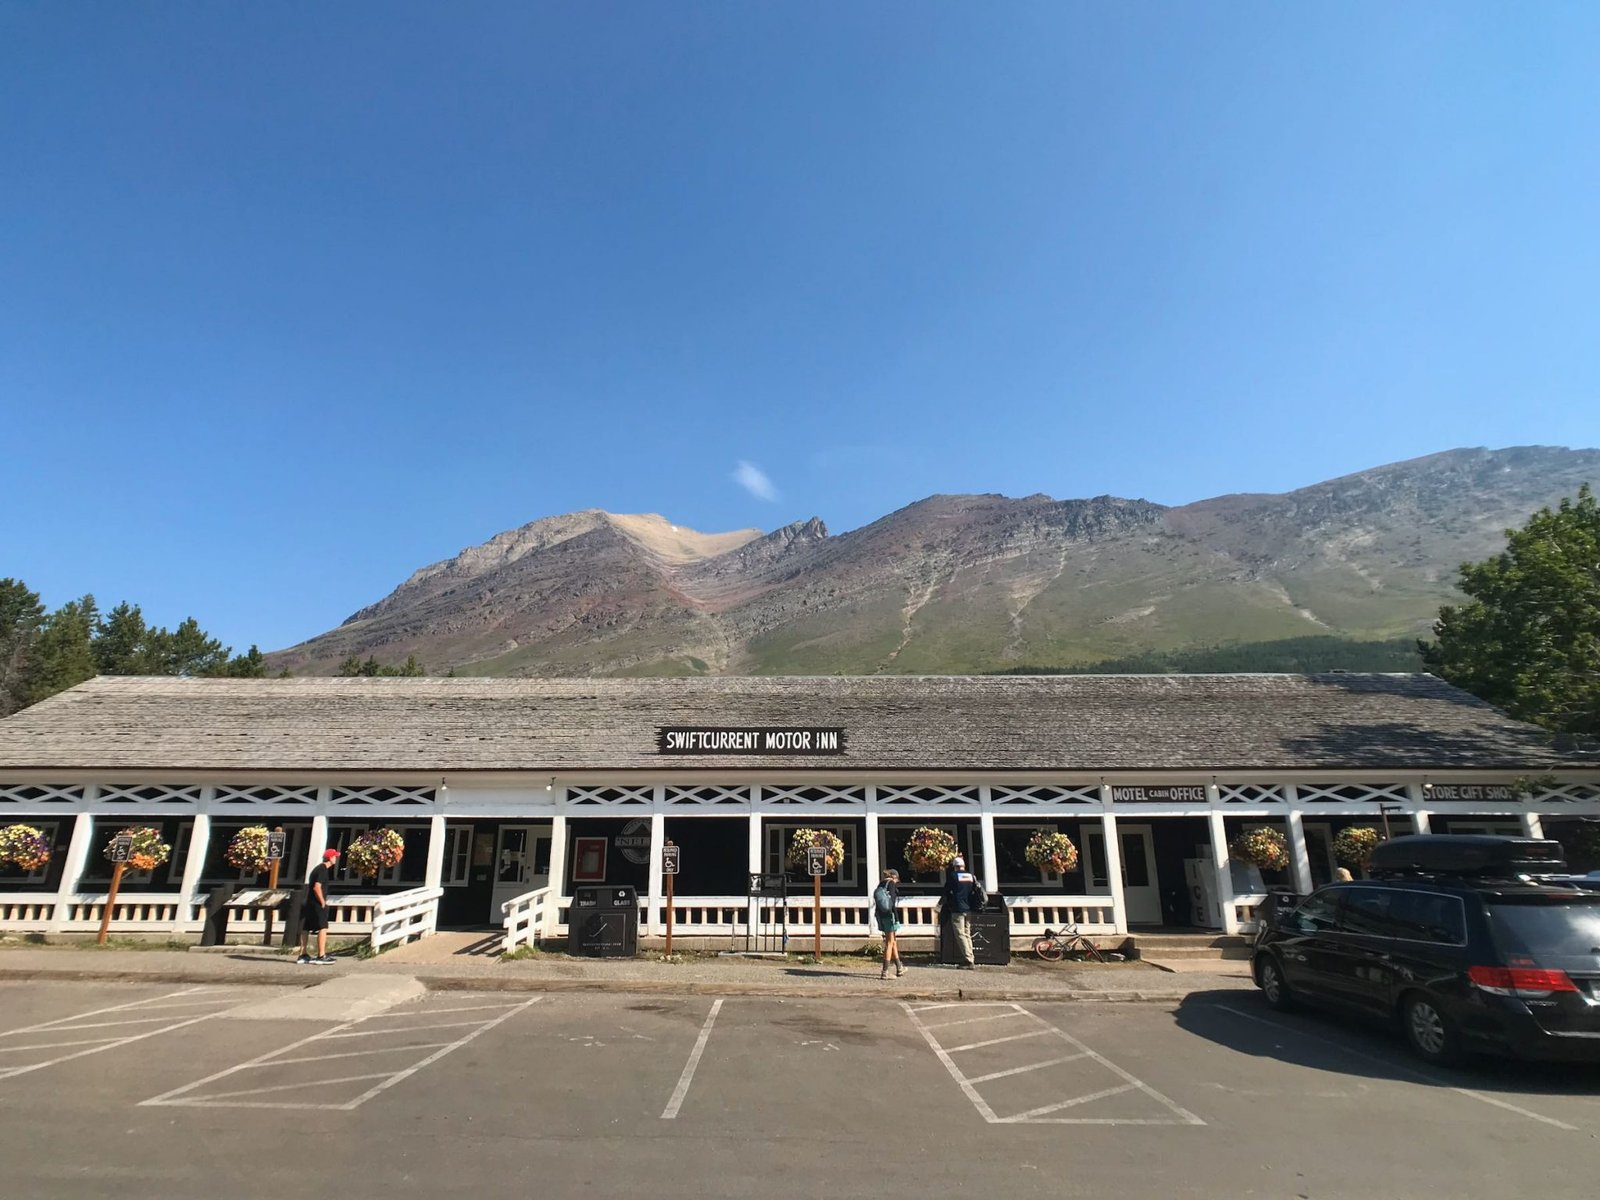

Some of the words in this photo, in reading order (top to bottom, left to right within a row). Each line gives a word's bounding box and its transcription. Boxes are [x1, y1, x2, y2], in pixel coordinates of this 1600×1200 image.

[666, 731, 759, 749] SWIFTCURRENT
[766, 731, 811, 749] MOTOR
[816, 731, 838, 749] INN
[1113, 787, 1148, 801] MOTEL
[1149, 790, 1169, 798] CABIN
[1170, 787, 1204, 800] OFFICE
[1423, 785, 1460, 799] STORE
[1461, 785, 1484, 799] GIFT
